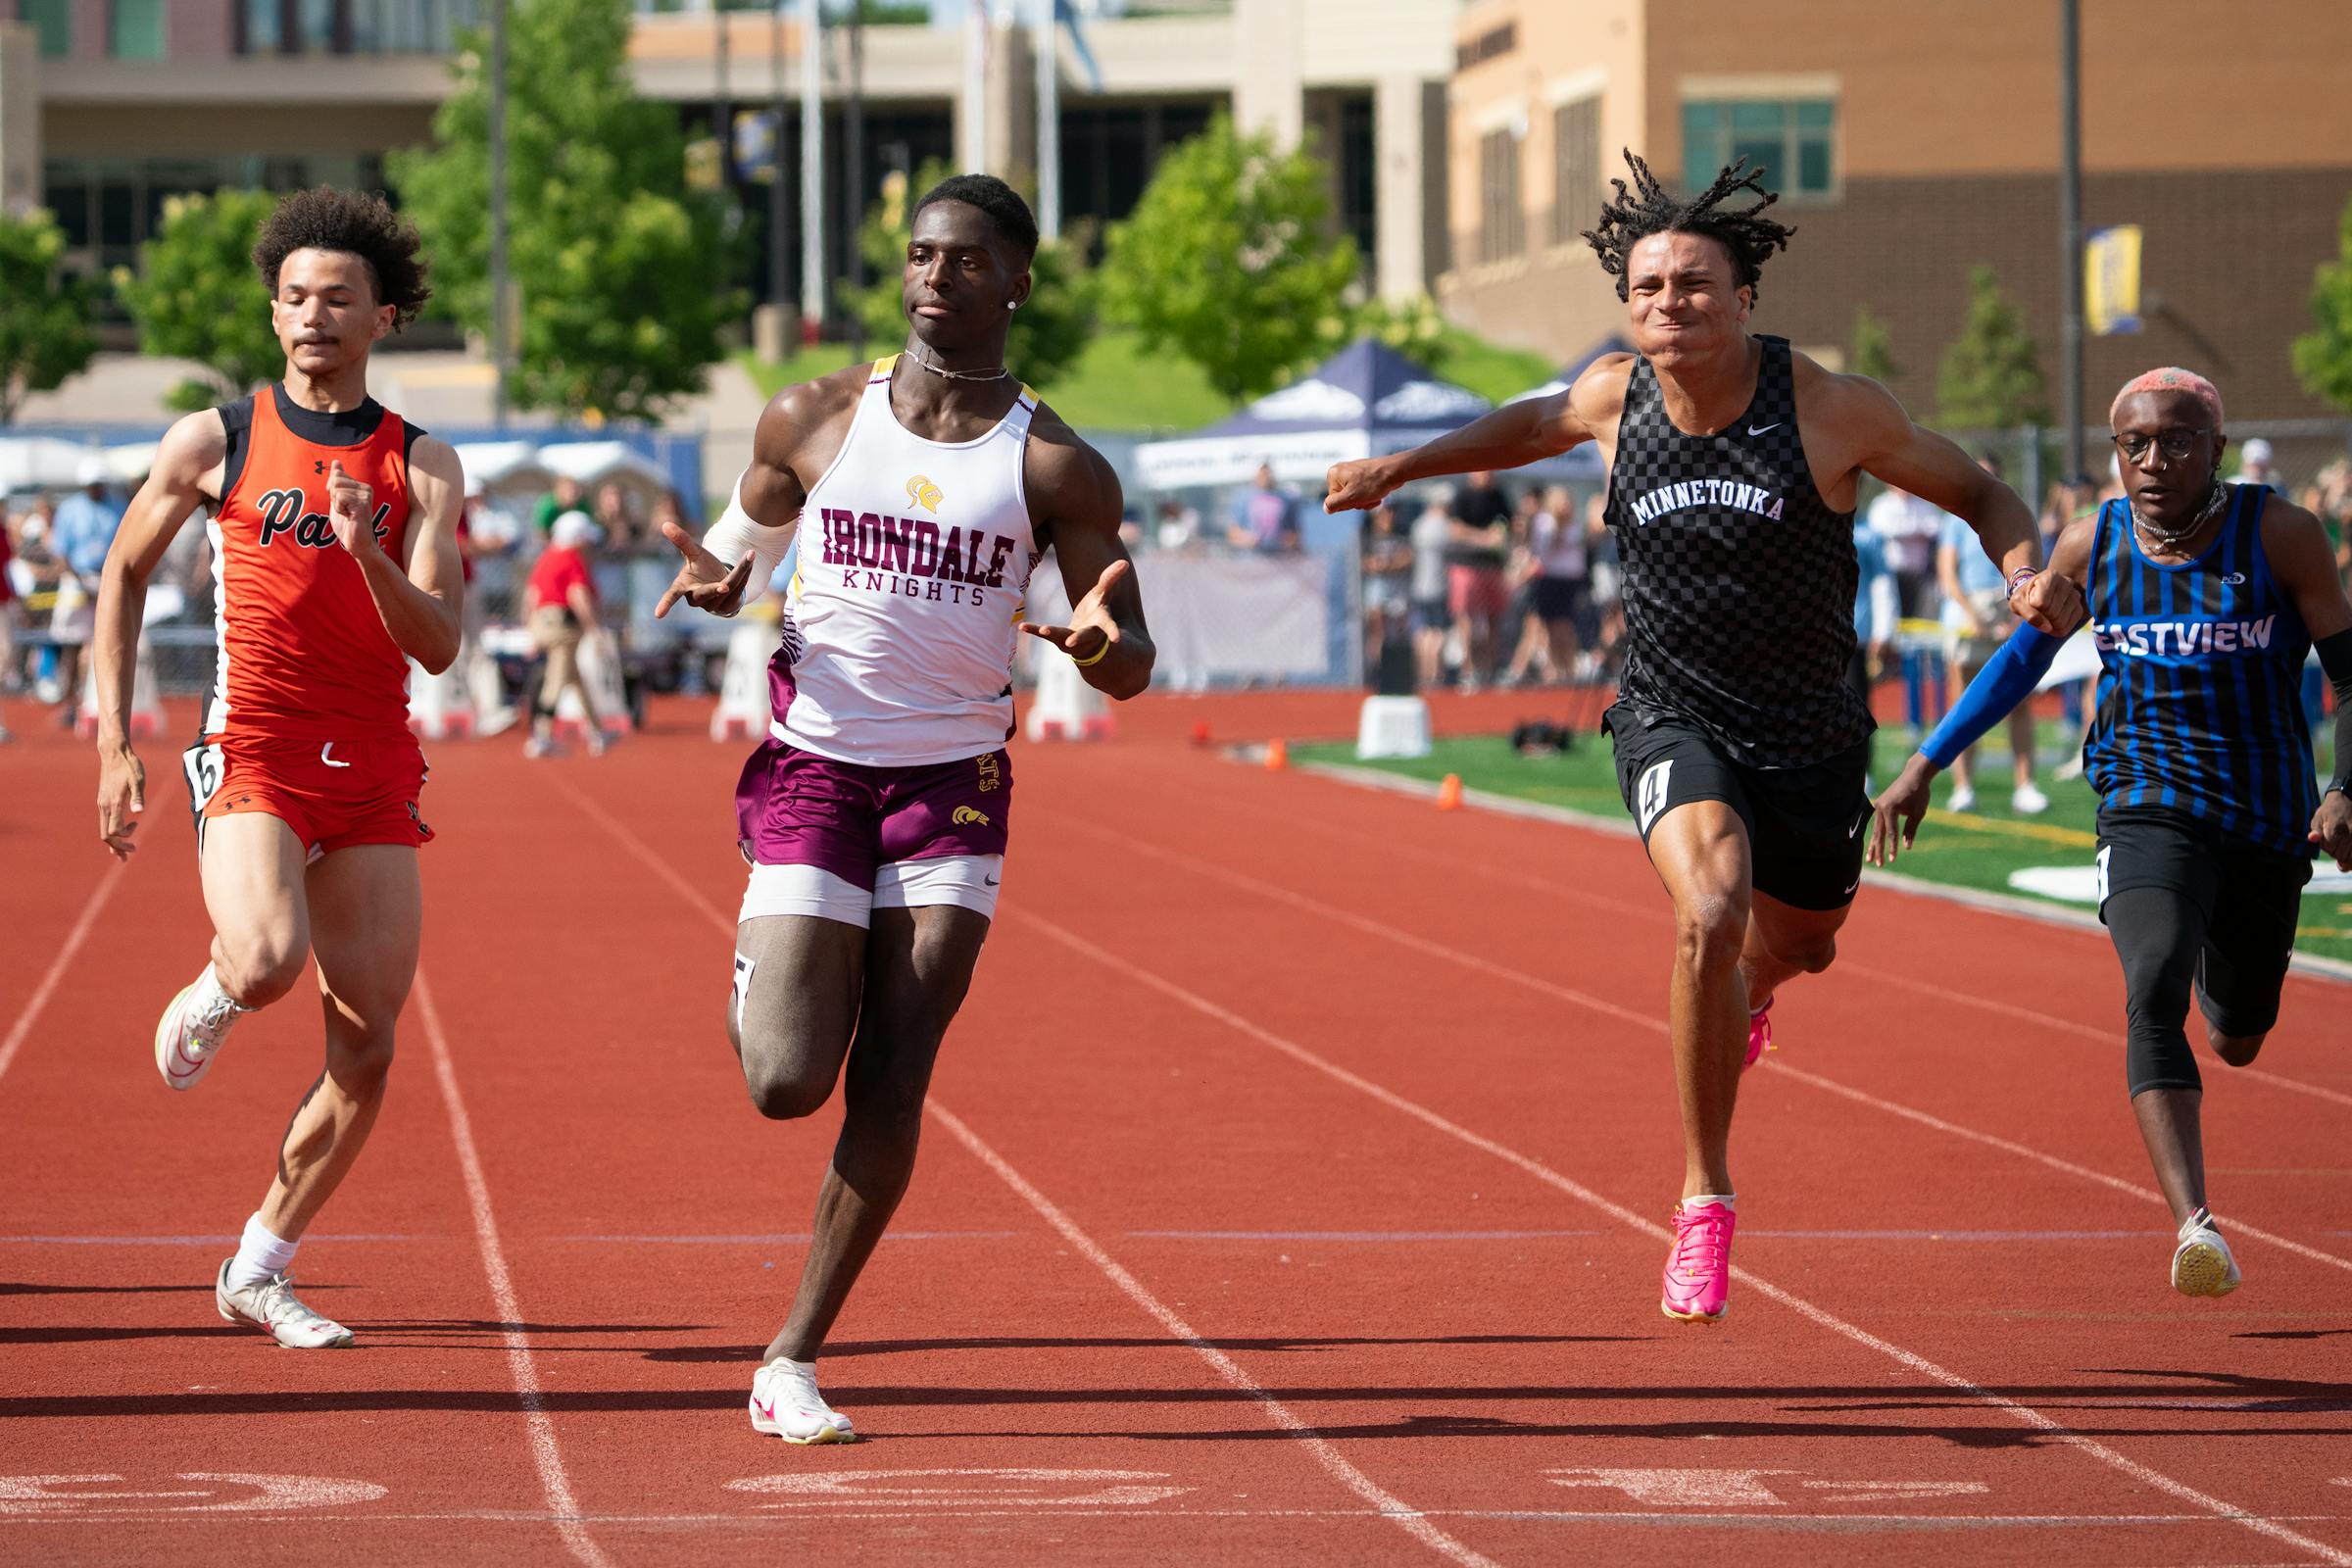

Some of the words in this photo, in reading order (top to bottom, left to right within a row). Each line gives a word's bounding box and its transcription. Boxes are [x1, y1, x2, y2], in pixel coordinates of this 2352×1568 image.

[1631, 479, 1785, 526] MINNETONKA
[821, 508, 1015, 588] IRONDALE
[843, 569, 985, 607] KNIGHTS
[2093, 614, 2277, 656] EASTVIEW
[196, 746, 217, 800] 6
[1644, 767, 1661, 816] 4
